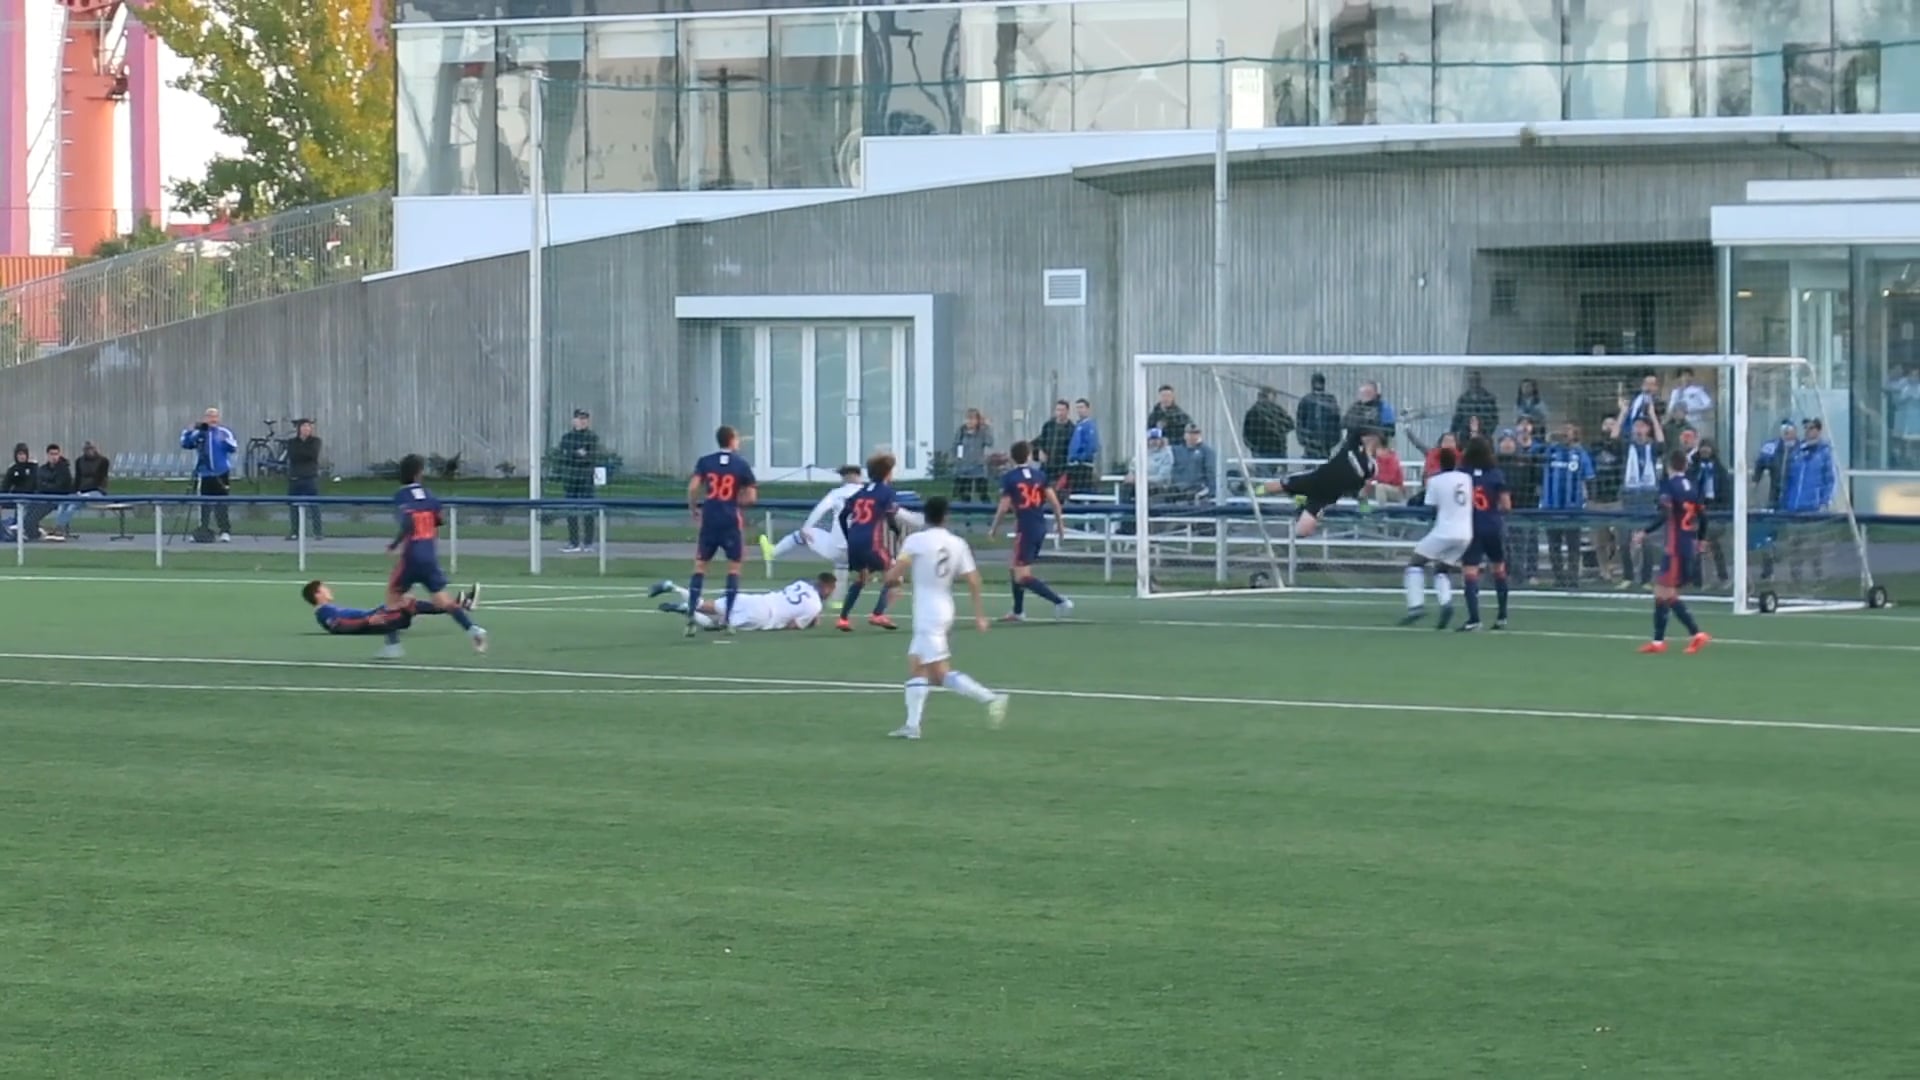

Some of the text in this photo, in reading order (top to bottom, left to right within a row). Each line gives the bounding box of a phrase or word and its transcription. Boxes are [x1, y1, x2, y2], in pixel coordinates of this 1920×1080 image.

[706, 473, 735, 501] 38
[1454, 483, 1467, 506] 6
[852, 498, 876, 524] 55
